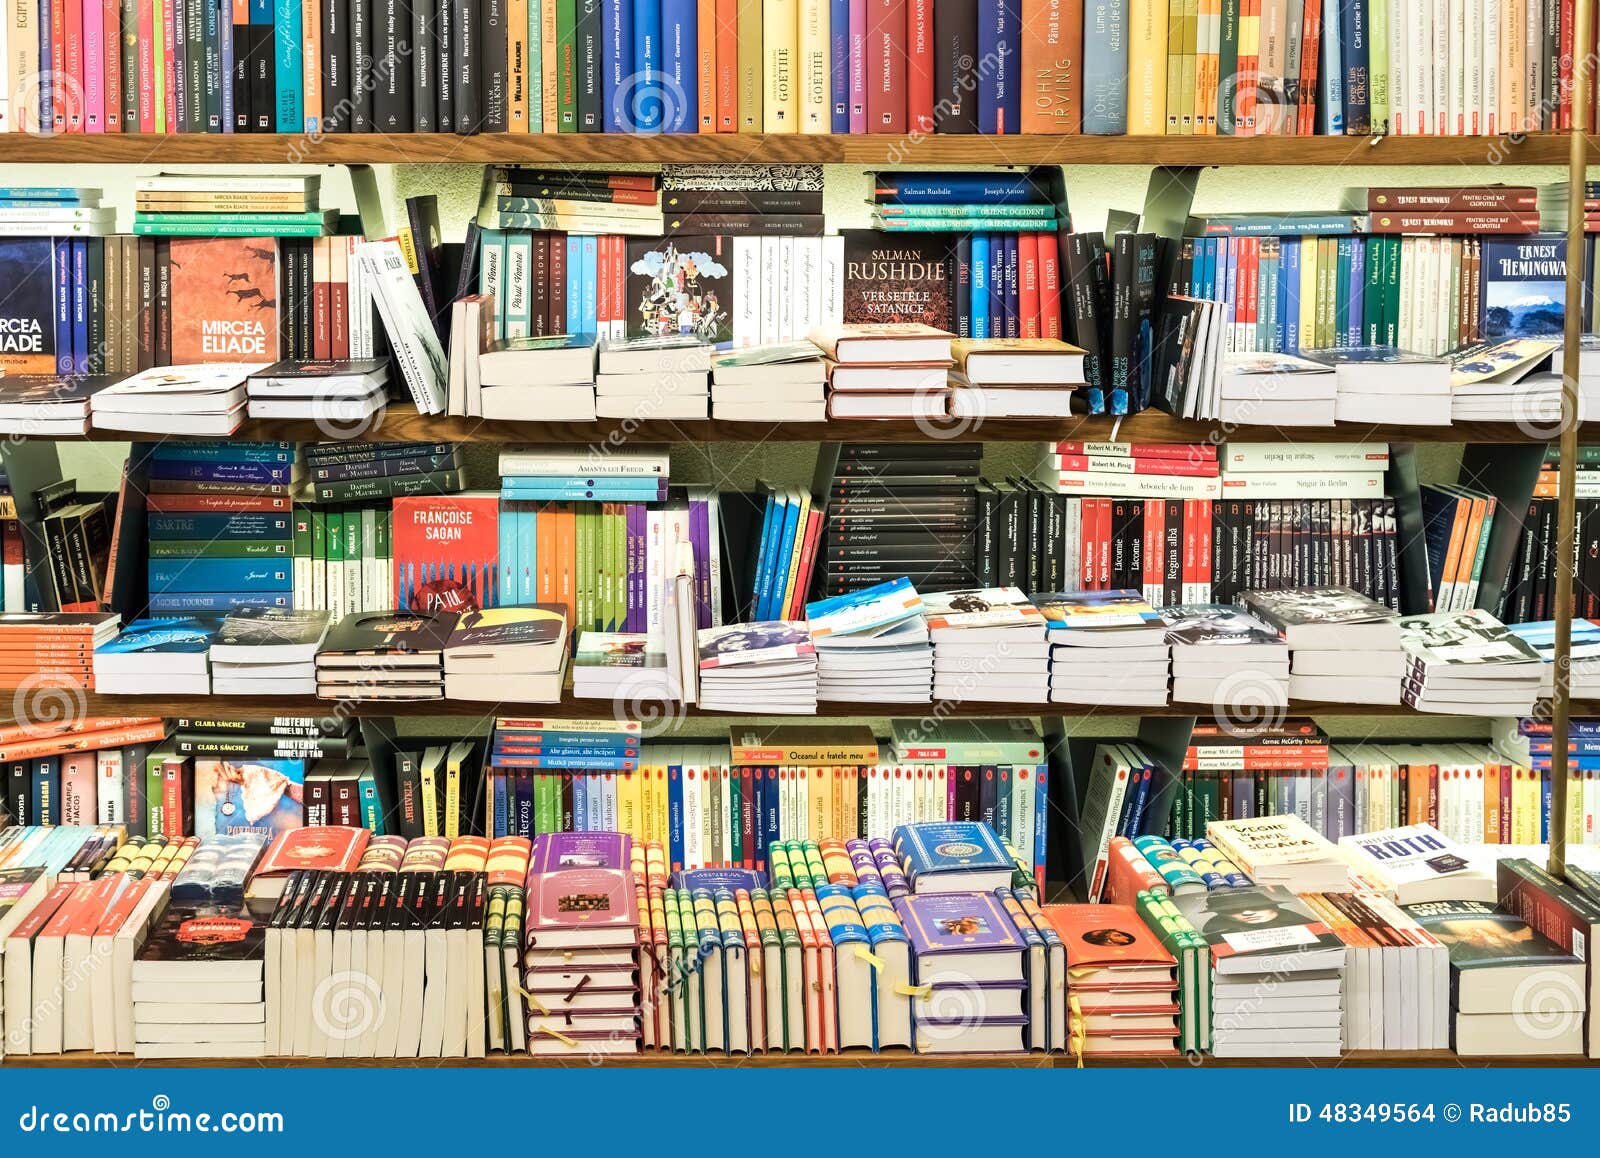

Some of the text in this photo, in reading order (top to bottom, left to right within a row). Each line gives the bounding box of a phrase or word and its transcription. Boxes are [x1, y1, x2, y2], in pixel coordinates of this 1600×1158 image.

[1096, 6, 1105, 33] Lumea
[141, 39, 149, 119] witold gombrowicz
[779, 49, 788, 101] GOETHE
[814, 51, 823, 104] GOETHE
[1037, 69, 1053, 116] JOHN
[1056, 59, 1071, 125] IRVING
[1349, 67, 1357, 105] Jorge Luis
[1357, 67, 1365, 105] BORGES
[872, 250, 920, 260] SALMAN
[1518, 246, 1556, 258] ERNEST
[848, 262, 944, 280] RUSHDIE
[862, 292, 929, 301] VERSETELE
[868, 304, 924, 314] SATANICE
[202, 320, 265, 335] MIRCEA
[202, 337, 265, 353] ELIADE
[1091, 356, 1099, 386] BORGES
[157, 521, 193, 530] SARTRE
[414, 511, 472, 526] FRANÇOISE
[426, 528, 461, 540] SAGAN
[1168, 550, 1178, 579] Regina
[157, 598, 214, 606] MICHEL TOURNIER
[274, 718, 315, 727] MISTERUL
[277, 740, 319, 749] MISTERUL
[827, 752, 847, 760] fratele
[520, 801, 530, 838] Herzog
[1018, 790, 1027, 850] Punct contrapunct
[1488, 809, 1497, 833] Fima
[1235, 824, 1287, 833] VEGHE
[1363, 834, 1447, 860] ROTH
[1414, 907, 1493, 917] WILLIS
